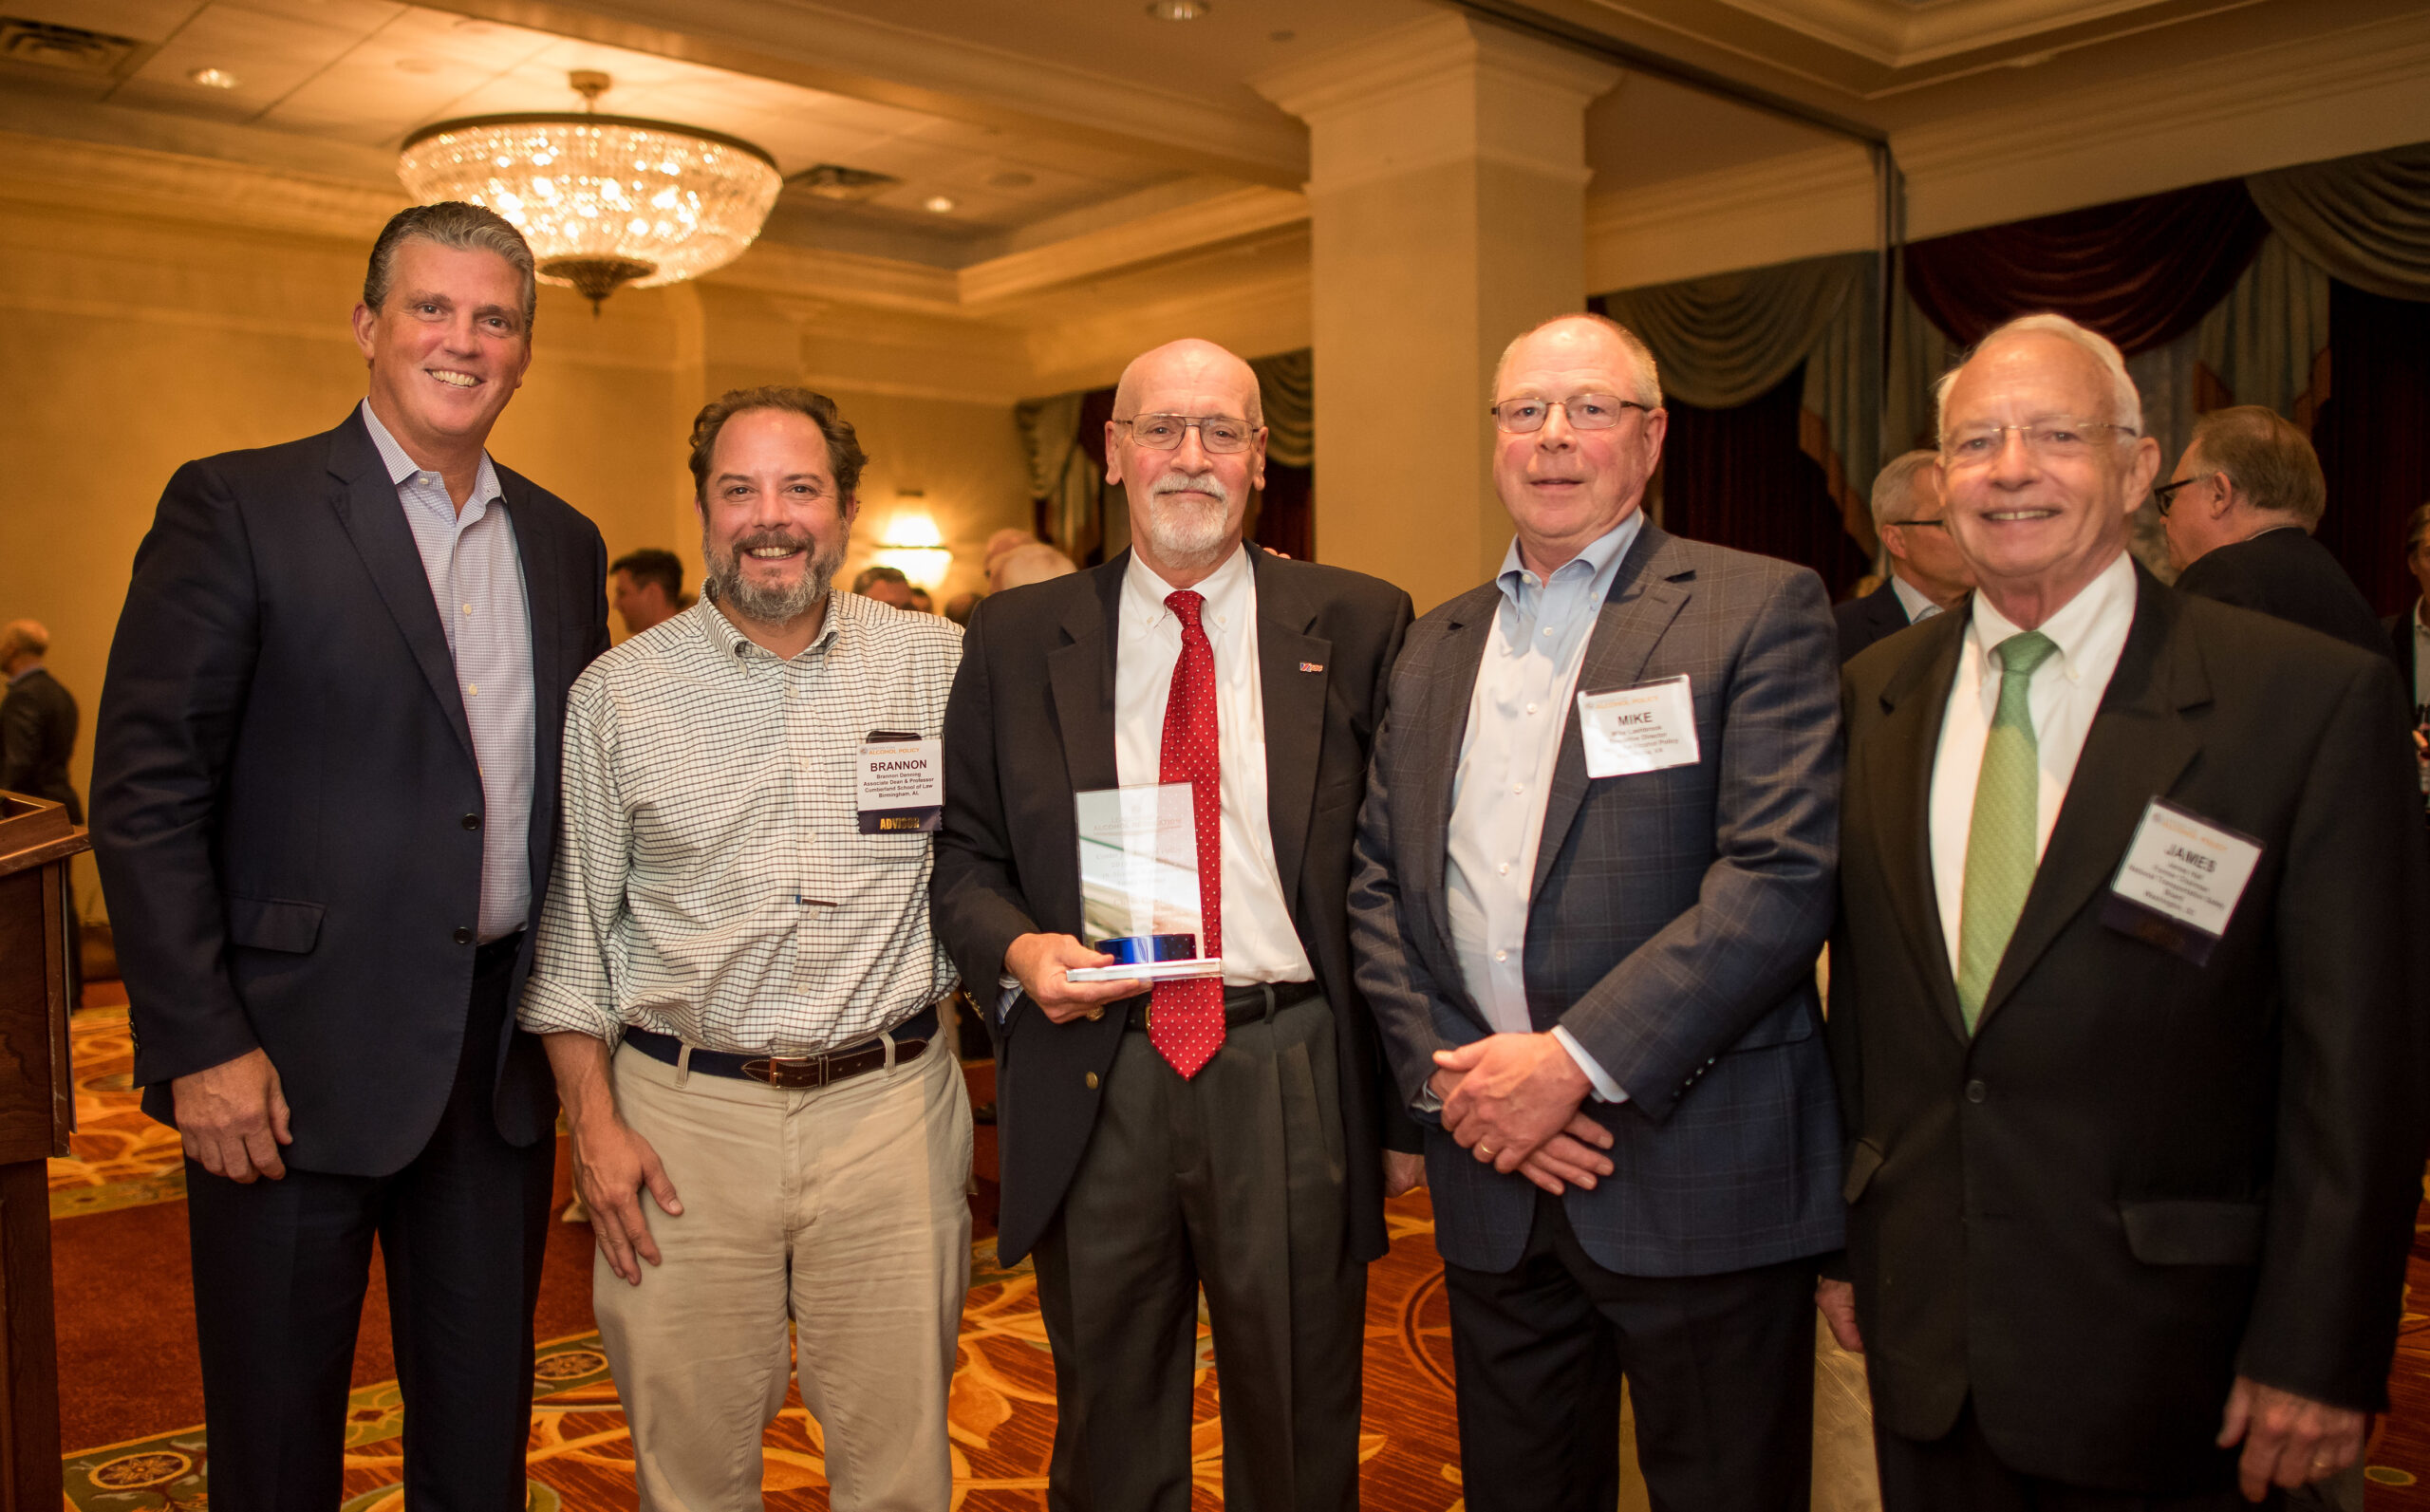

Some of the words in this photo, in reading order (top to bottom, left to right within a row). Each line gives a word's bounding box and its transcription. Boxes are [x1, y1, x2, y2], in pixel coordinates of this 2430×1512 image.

[1617, 712, 1653, 726] MIKE
[870, 759, 927, 772] BRANNON
[880, 817, 920, 830] ADVISOR
[2163, 843, 2218, 873] JAMES
